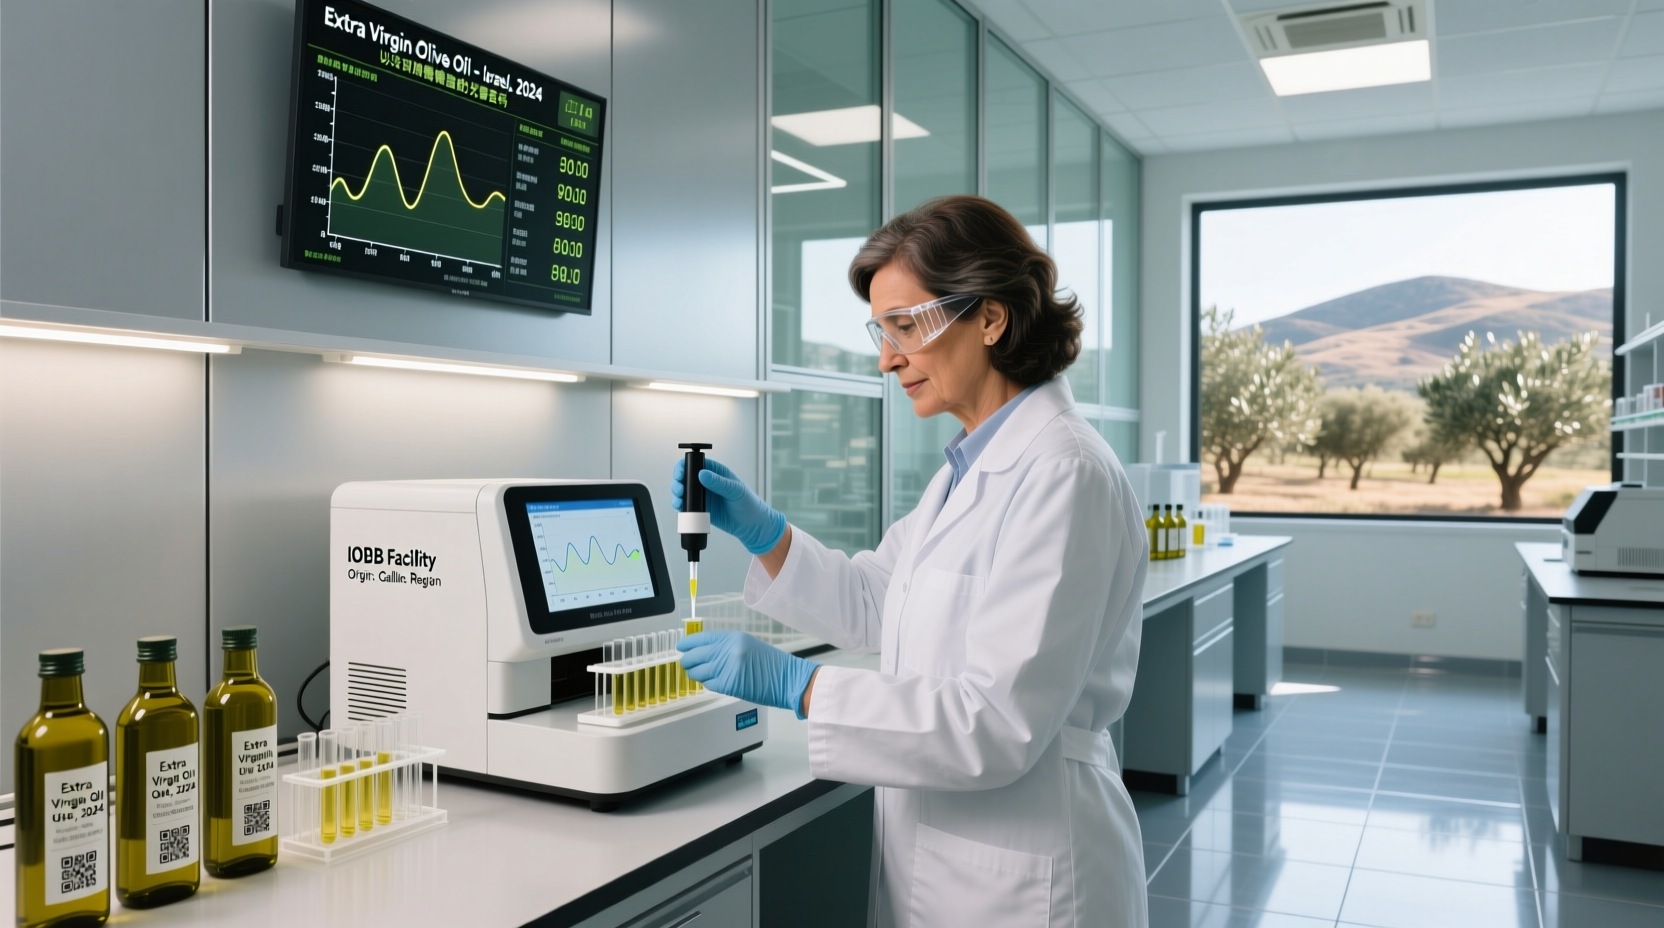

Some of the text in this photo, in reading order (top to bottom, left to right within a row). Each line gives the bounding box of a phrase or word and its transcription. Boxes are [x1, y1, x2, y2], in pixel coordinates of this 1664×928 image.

[324, 6, 366, 38] Extra
[369, 22, 412, 54] Virgin
[415, 40, 450, 68] Olive
[453, 55, 471, 76] Oil
[515, 78, 542, 102] 2024
[347, 546, 384, 565] IOBB
